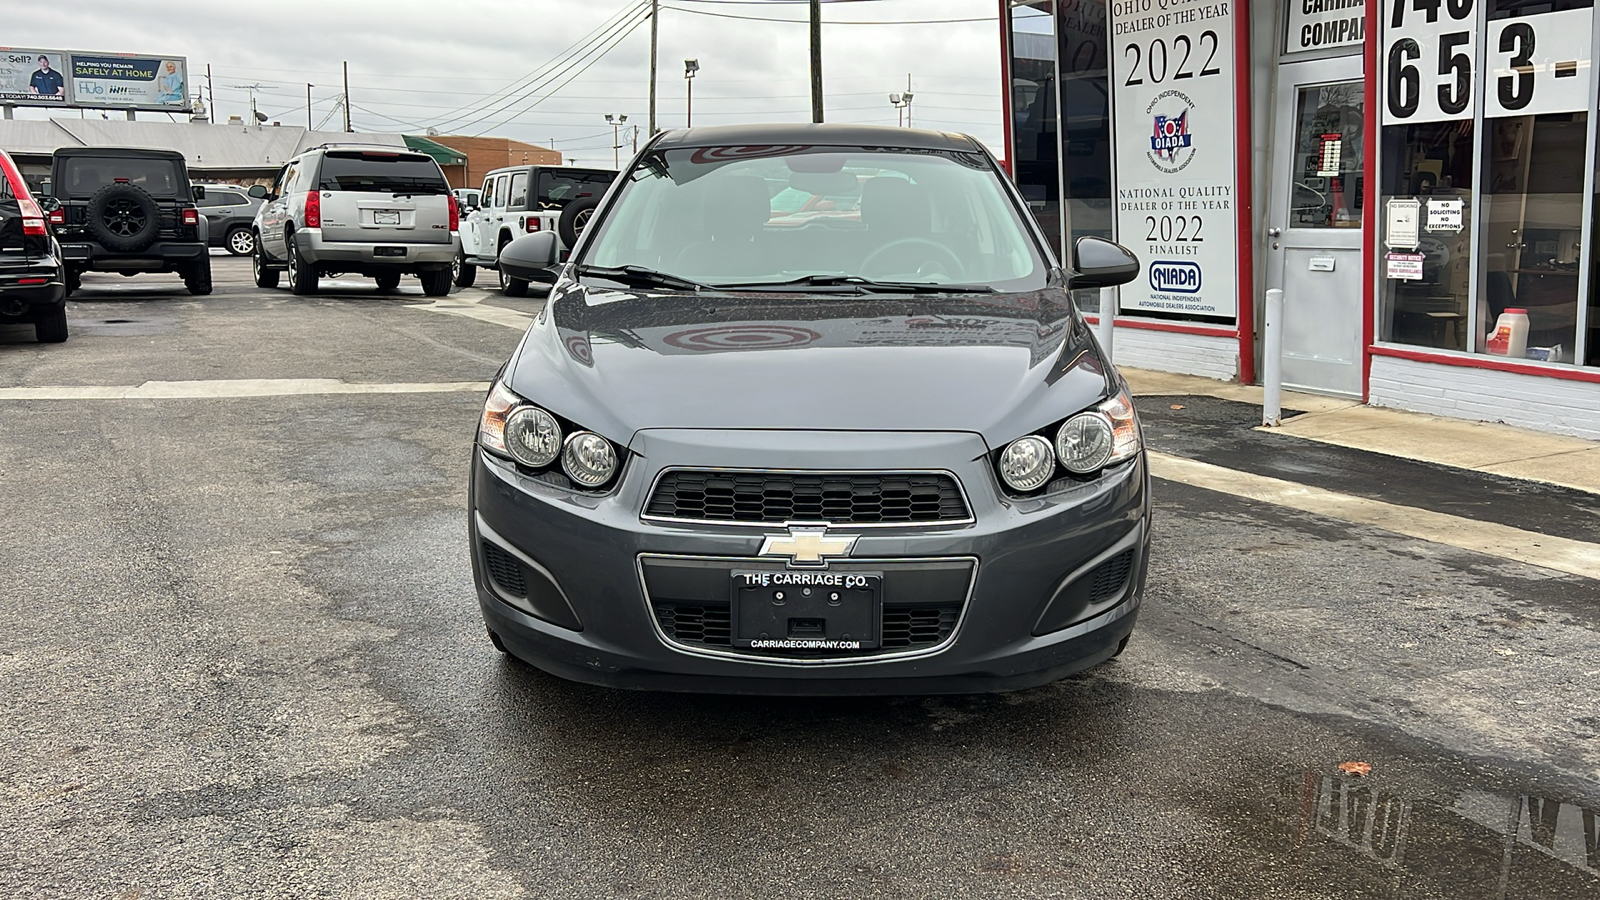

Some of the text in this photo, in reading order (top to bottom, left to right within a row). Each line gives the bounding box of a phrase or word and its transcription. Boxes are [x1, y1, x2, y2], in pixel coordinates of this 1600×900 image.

[1115, 17, 1155, 35] DEALER
[1157, 14, 1171, 28] OF
[1173, 9, 1196, 24] THE
[1198, 3, 1229, 20] YEAR
[1301, 16, 1366, 47] COMPA
[8, 55, 32, 64] Sell?
[1124, 30, 1220, 86] 2022
[76, 67, 109, 76] SAFELY
[126, 70, 153, 78] HOME
[1146, 89, 1196, 115] OHIO INDEPENDENT
[1155, 136, 1185, 148] OIADA
[1119, 186, 1231, 199] NATIONAL QUALITY
[1120, 200, 1230, 210] DEALER OF THE YEAR
[1145, 215, 1204, 242] 2022
[1149, 245, 1198, 255] FINALIST
[1153, 268, 1197, 287] NIADA
[1172, 295, 1202, 303] INDEPENDENT
[1185, 303, 1215, 312] ASSOCIATION
[744, 573, 869, 587] THE CARRIAGE CO.
[751, 640, 860, 649] CARRIAGECOMPANY.COM
